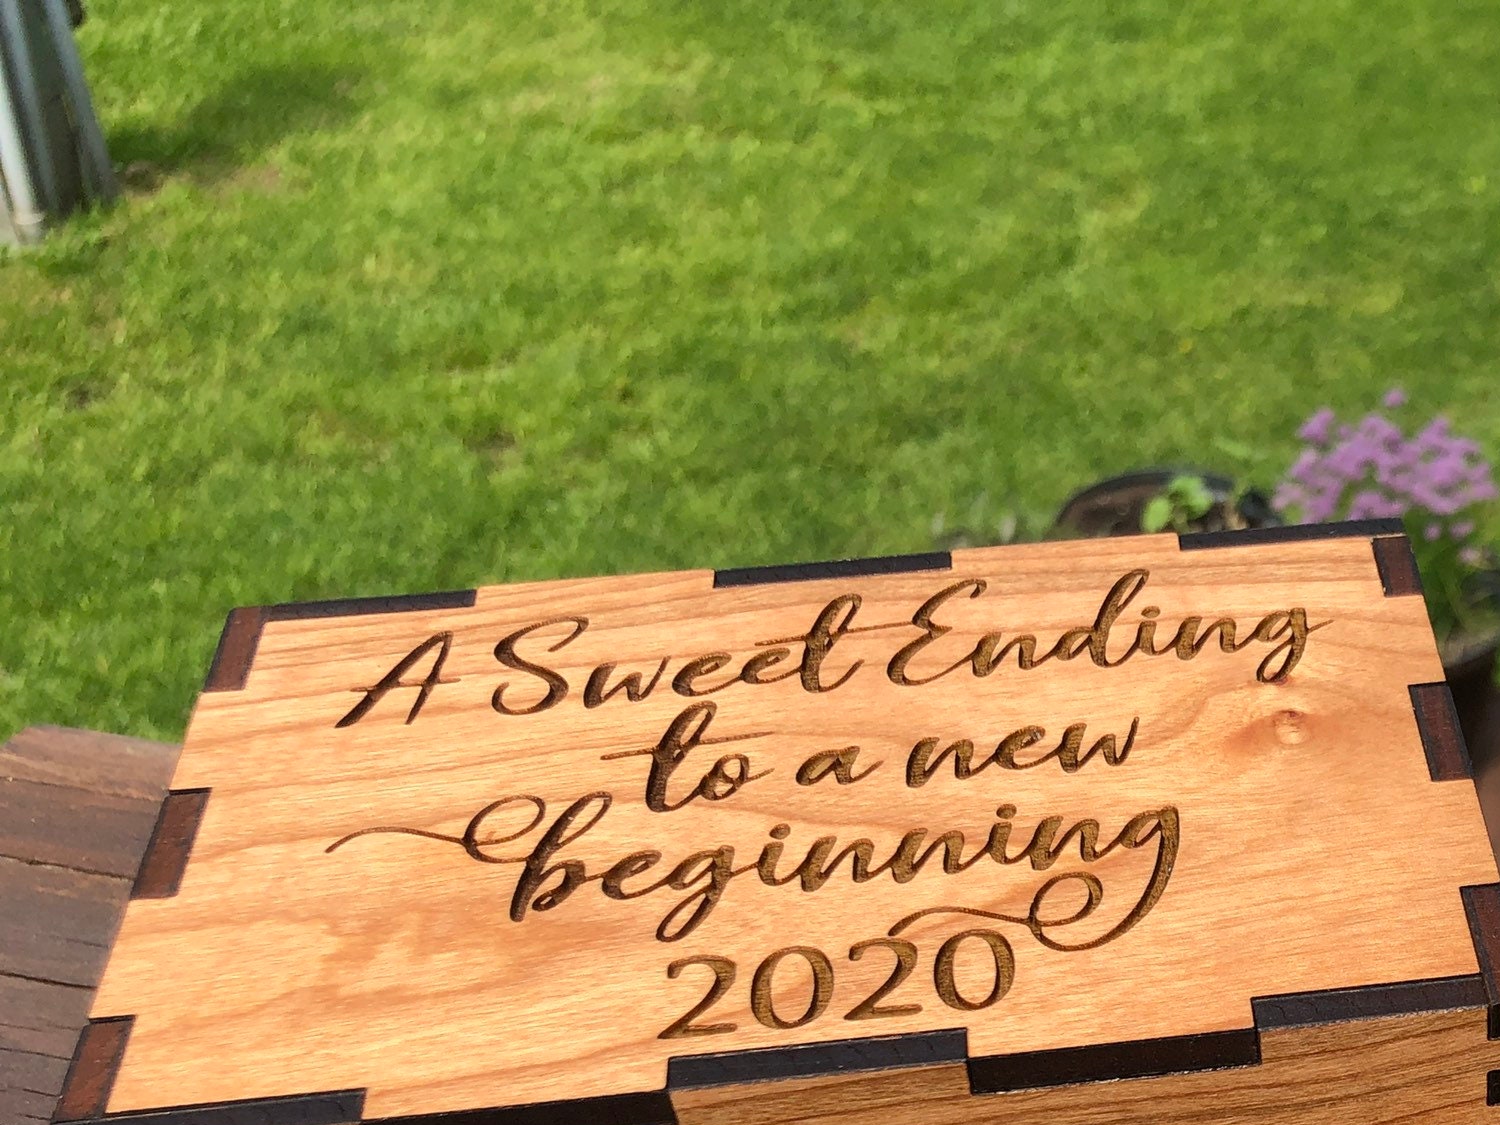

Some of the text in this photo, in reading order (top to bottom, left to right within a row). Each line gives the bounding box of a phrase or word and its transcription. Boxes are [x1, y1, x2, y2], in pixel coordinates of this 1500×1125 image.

[335, 569, 1334, 727] A Sweet Ending
[600, 701, 1140, 812] to a new
[325, 792, 1179, 951] beginning
[658, 928, 1015, 1040] 2020
